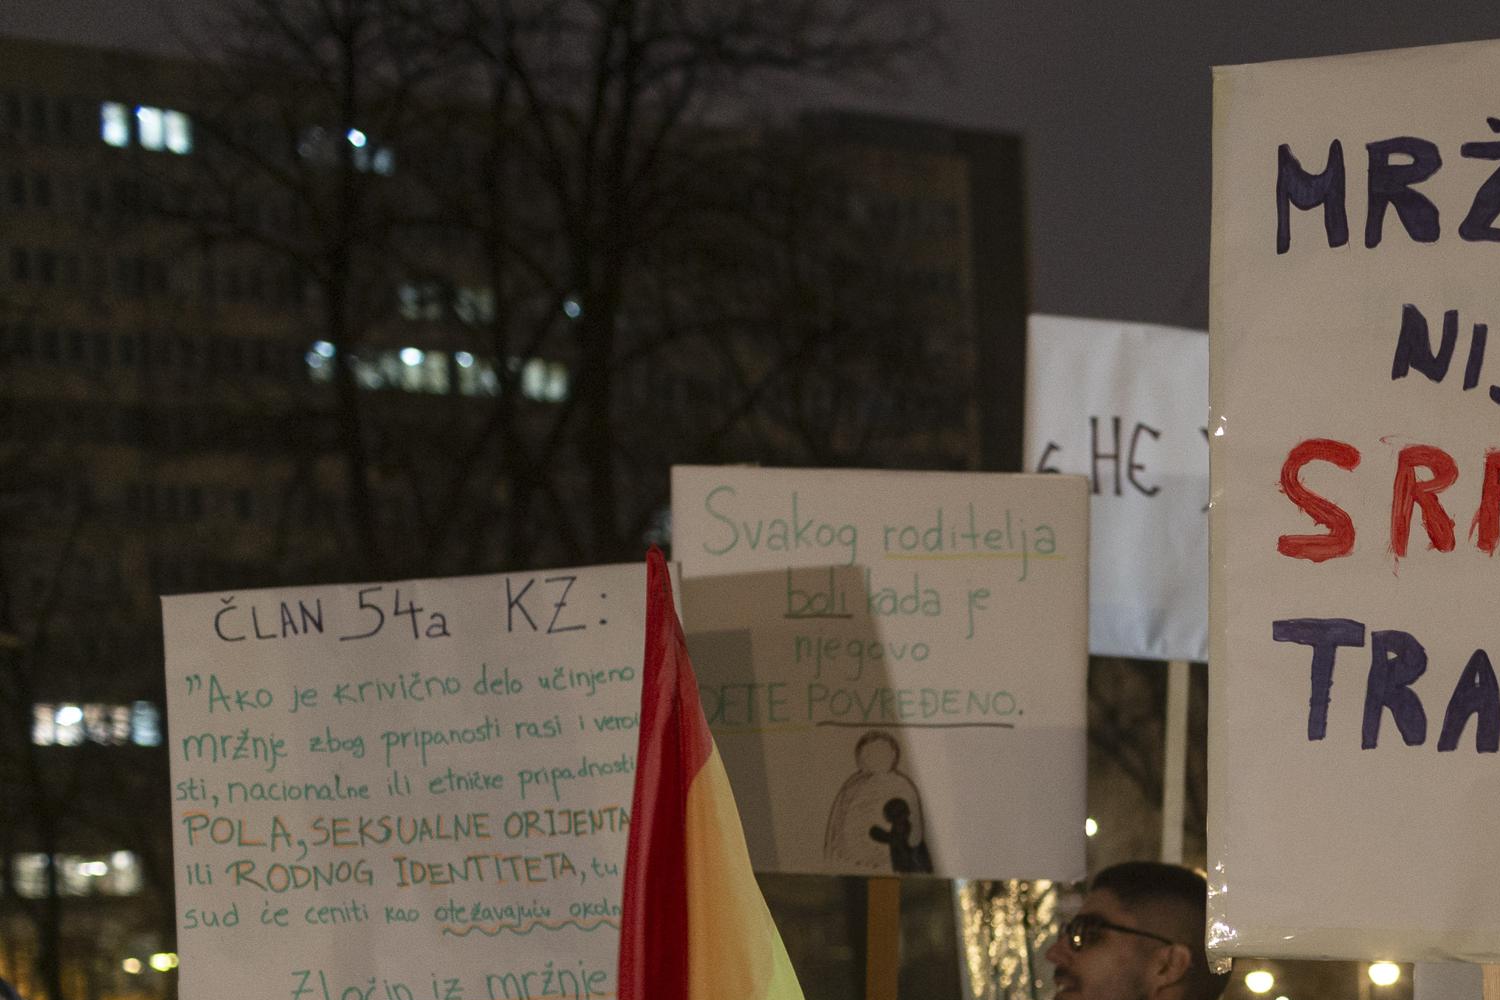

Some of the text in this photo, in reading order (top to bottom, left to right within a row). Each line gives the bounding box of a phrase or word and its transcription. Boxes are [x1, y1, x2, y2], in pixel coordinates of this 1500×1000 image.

[701, 485, 1058, 583] Svakog roditelja
[213, 575, 608, 643] ČLAN 54a KZ:
[786, 565, 992, 640] boli kada je
[794, 634, 931, 683] njegovo
[287, 685, 319, 714] je
[332, 670, 462, 705] krivično
[473, 662, 523, 696] delo
[538, 665, 636, 698] učinjeno
[181, 727, 289, 774] mržnje
[309, 725, 366, 760] zbog
[514, 714, 563, 741] rasi
[578, 714, 586, 732] i
[227, 773, 371, 804] nacionalne
[386, 769, 412, 797] ili
[427, 766, 505, 796] etničke
[185, 862, 214, 887] ili
[225, 858, 375, 894] RODNOG
[392, 851, 587, 889] IDENTITETA,
[183, 901, 241, 930] sud
[304, 899, 370, 926] ceniti
[384, 903, 420, 926] kao
